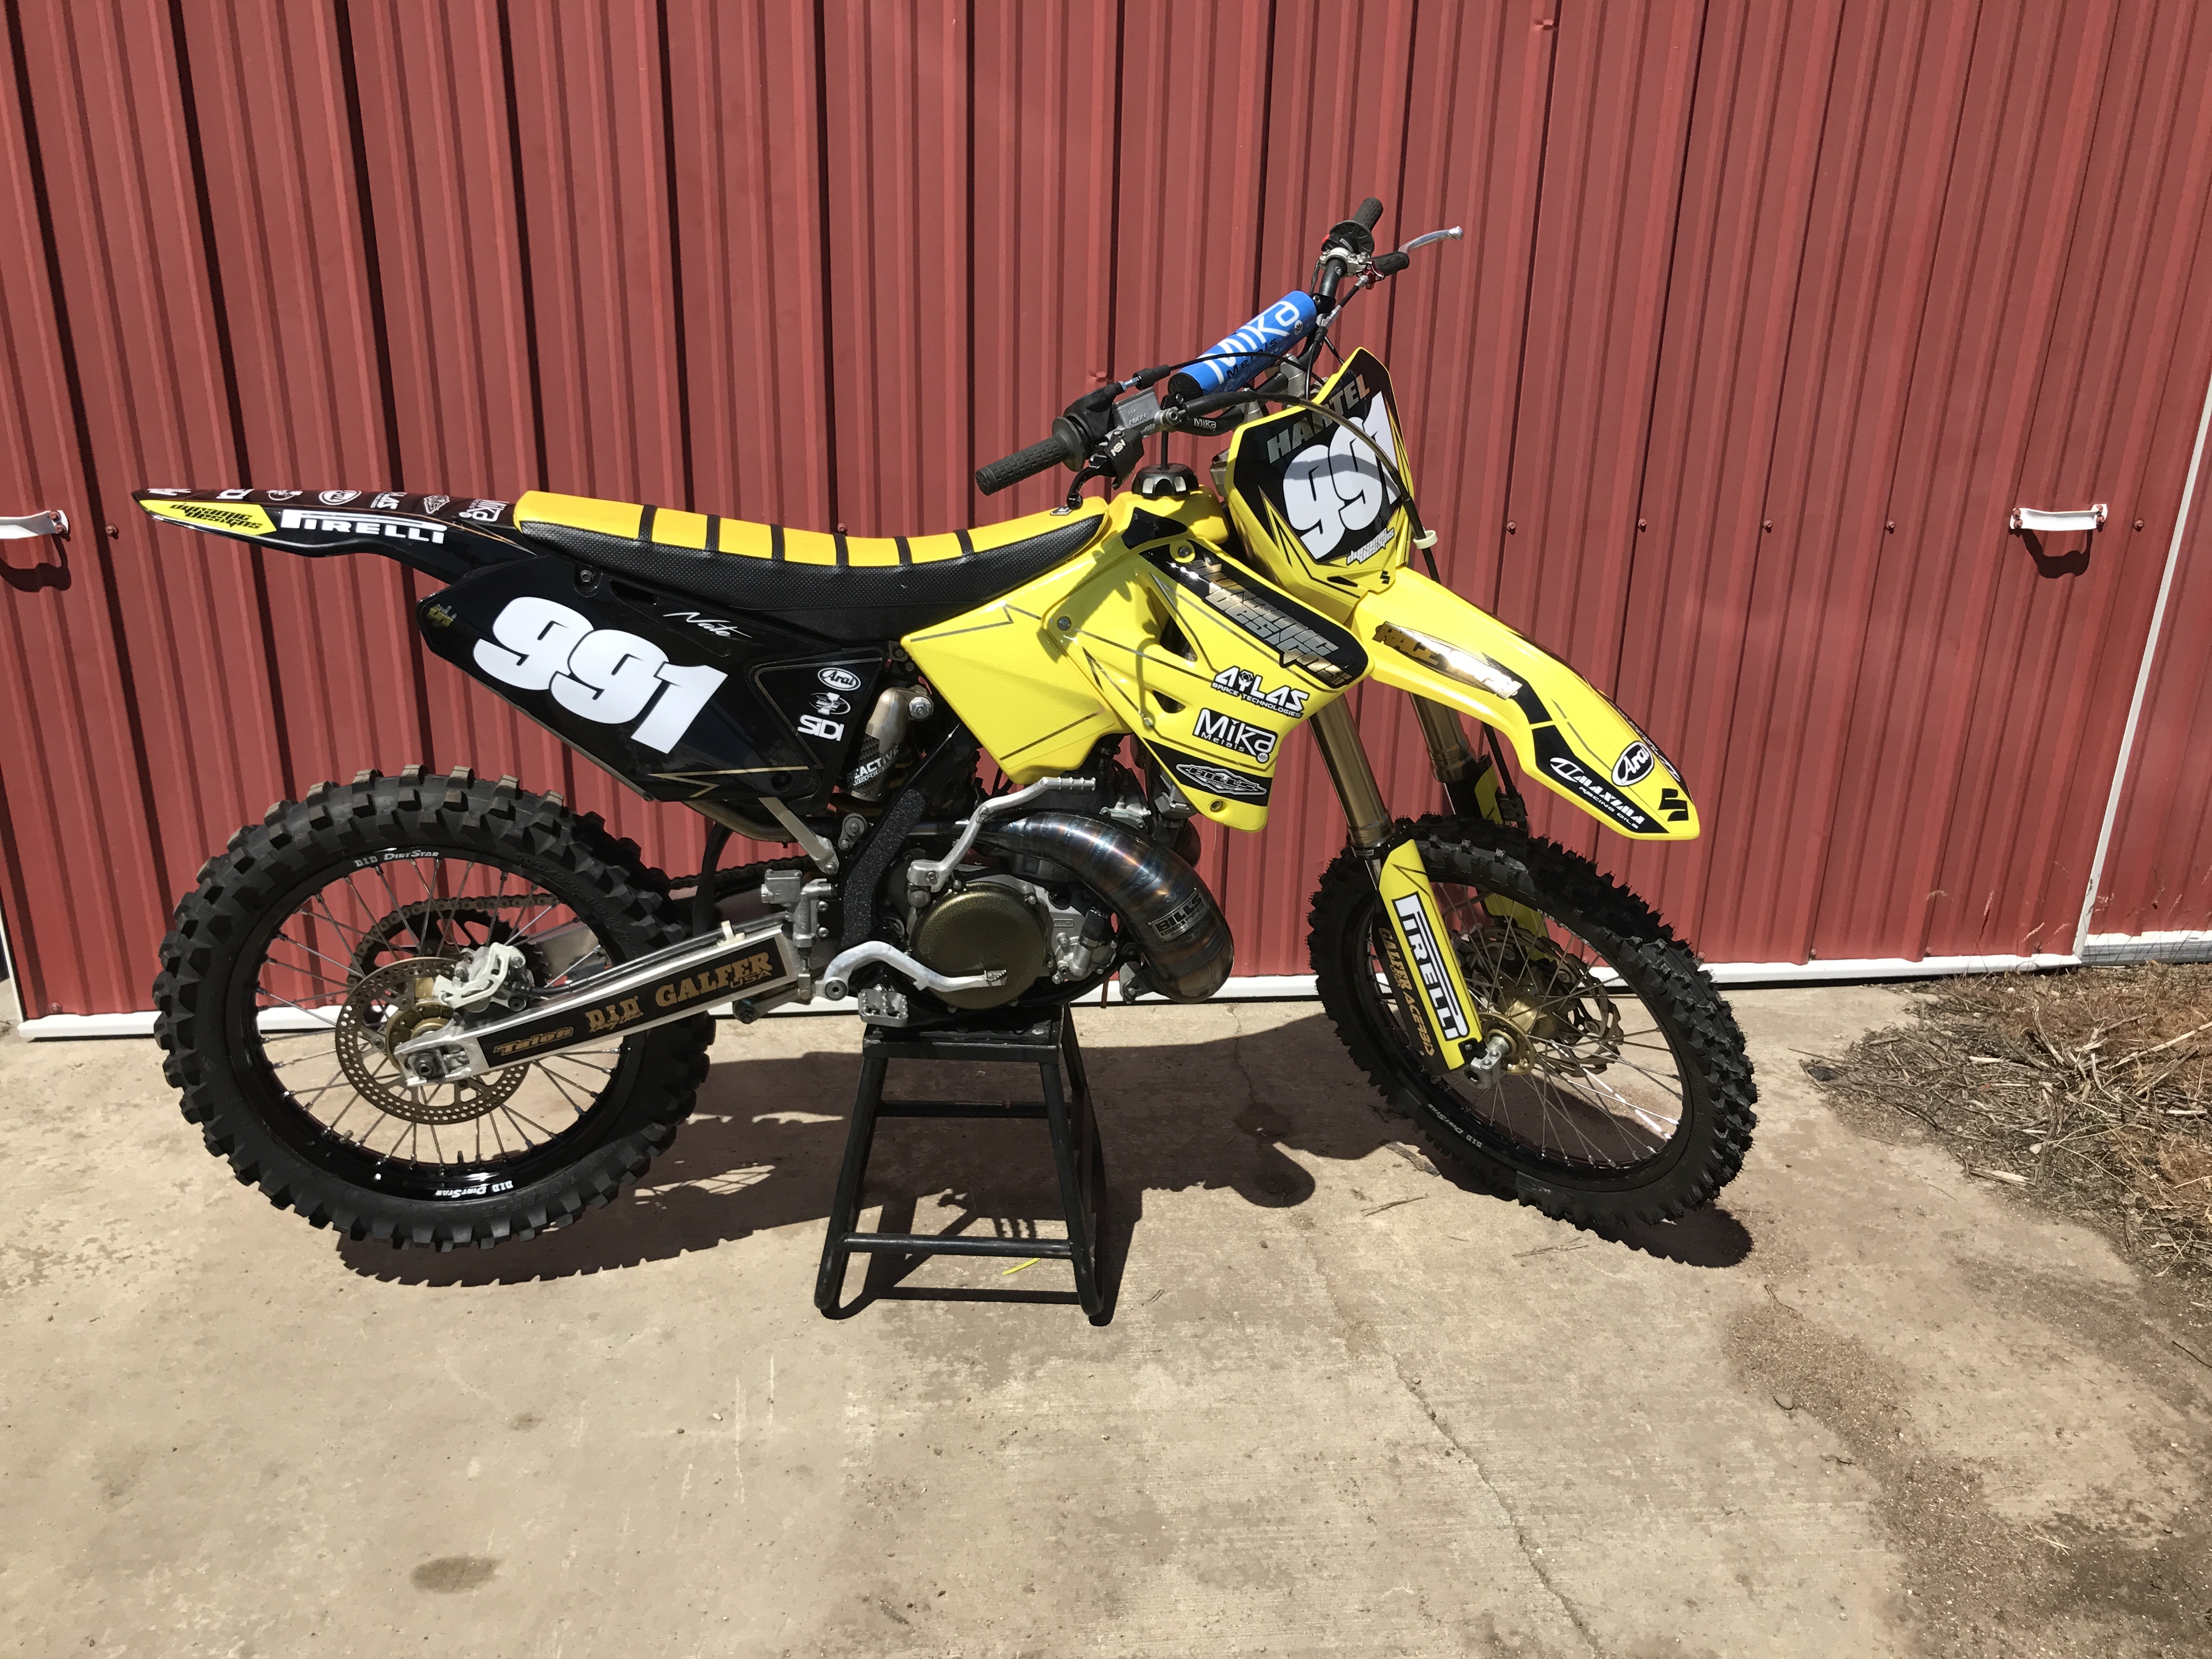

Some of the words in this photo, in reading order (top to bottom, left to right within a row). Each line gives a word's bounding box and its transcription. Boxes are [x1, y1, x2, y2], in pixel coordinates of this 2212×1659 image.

[1283, 391, 1400, 559] 991
[280, 509, 448, 545] PIRELLI
[1359, 528, 1394, 563] designs
[473, 596, 728, 754] 991
[823, 670, 856, 686] Arai
[1212, 682, 1239, 696] BRACE
[1242, 693, 1303, 718] TECHNOLOGIES
[1201, 732, 1245, 752] Metals
[1621, 745, 1650, 785] Arai
[1572, 775, 1645, 825] MAXIMA
[1578, 786, 1615, 813] RACING
[1616, 812, 1639, 830] OILS
[1154, 893, 1202, 932] BILL'S
[731, 968, 772, 989] USA
[1394, 894, 1468, 1040] PIRELLI
[494, 1026, 574, 1056] Talon
[656, 951, 773, 1007] GALFER
